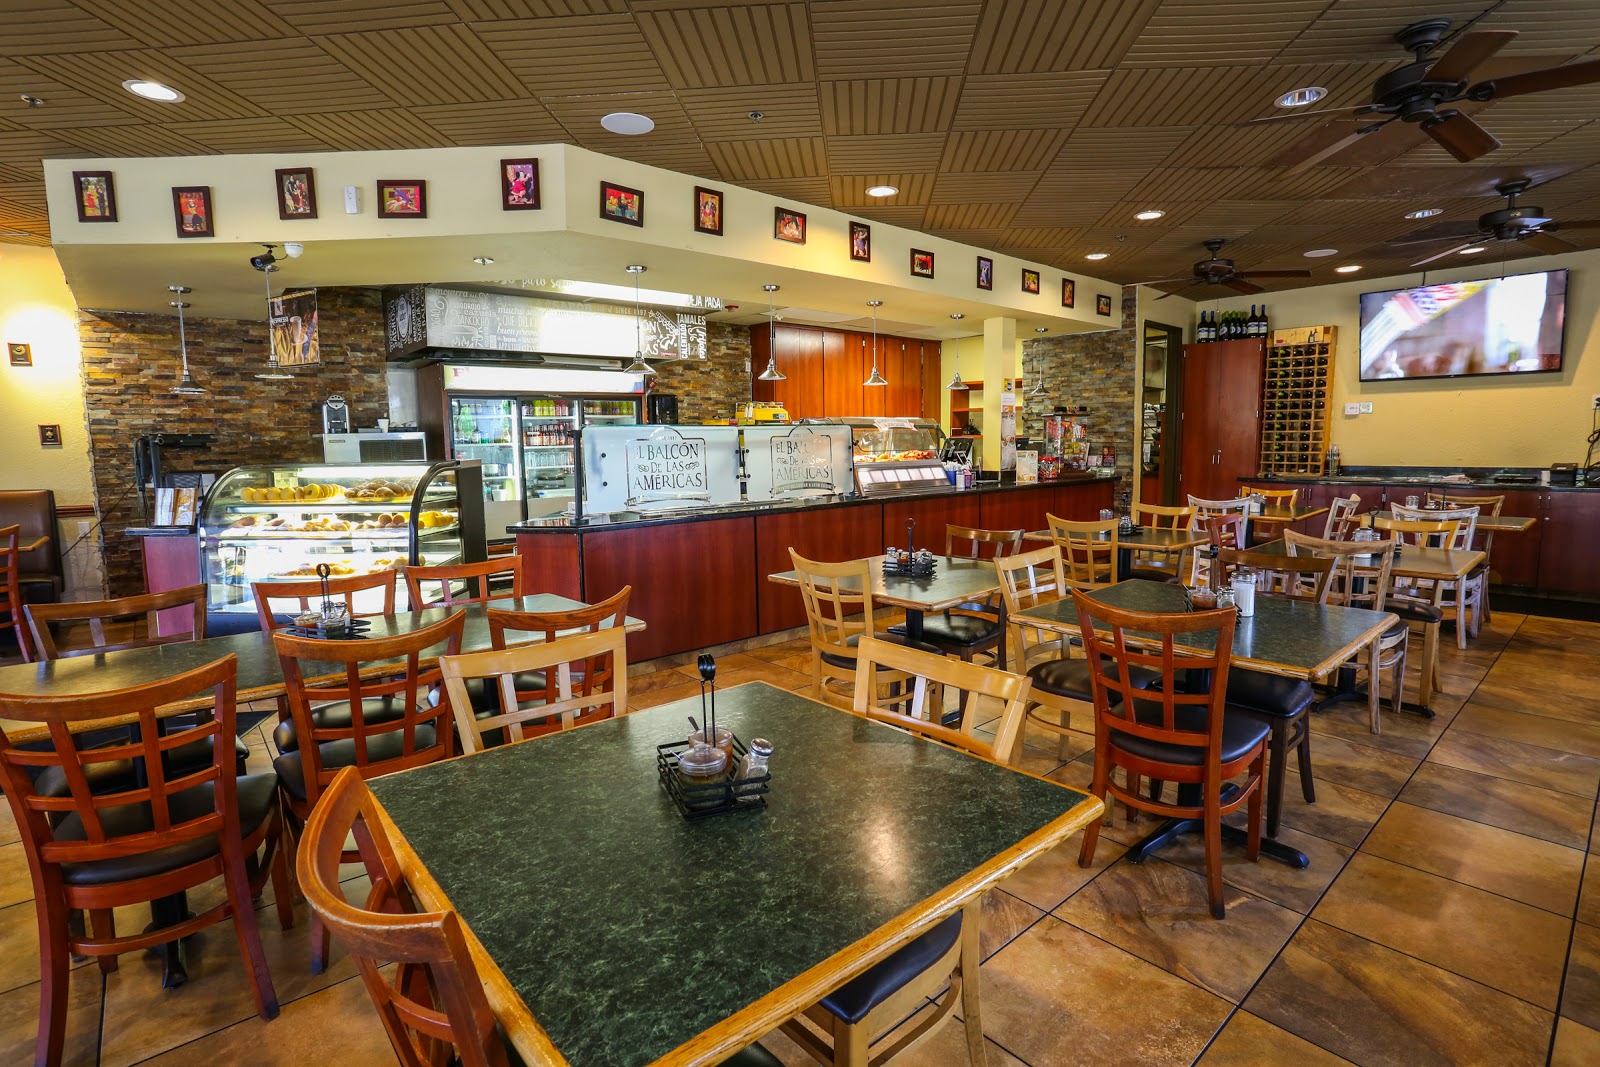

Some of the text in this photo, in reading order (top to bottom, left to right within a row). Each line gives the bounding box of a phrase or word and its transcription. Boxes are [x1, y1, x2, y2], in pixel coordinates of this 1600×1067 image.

[615, 307, 631, 315] SINCE
[458, 315, 490, 327] SANCOCHO
[502, 315, 538, 328] QUE DELICI
[676, 313, 706, 326] TAMALES
[680, 324, 688, 358] CALENTADO
[647, 442, 699, 460] BALCÓN
[776, 441, 785, 453] EL
[651, 461, 684, 473] DE LAS
[790, 456, 798, 465] DE
[776, 465, 829, 480] AMÉRICAS
[633, 472, 703, 490] AMÉRICAS
